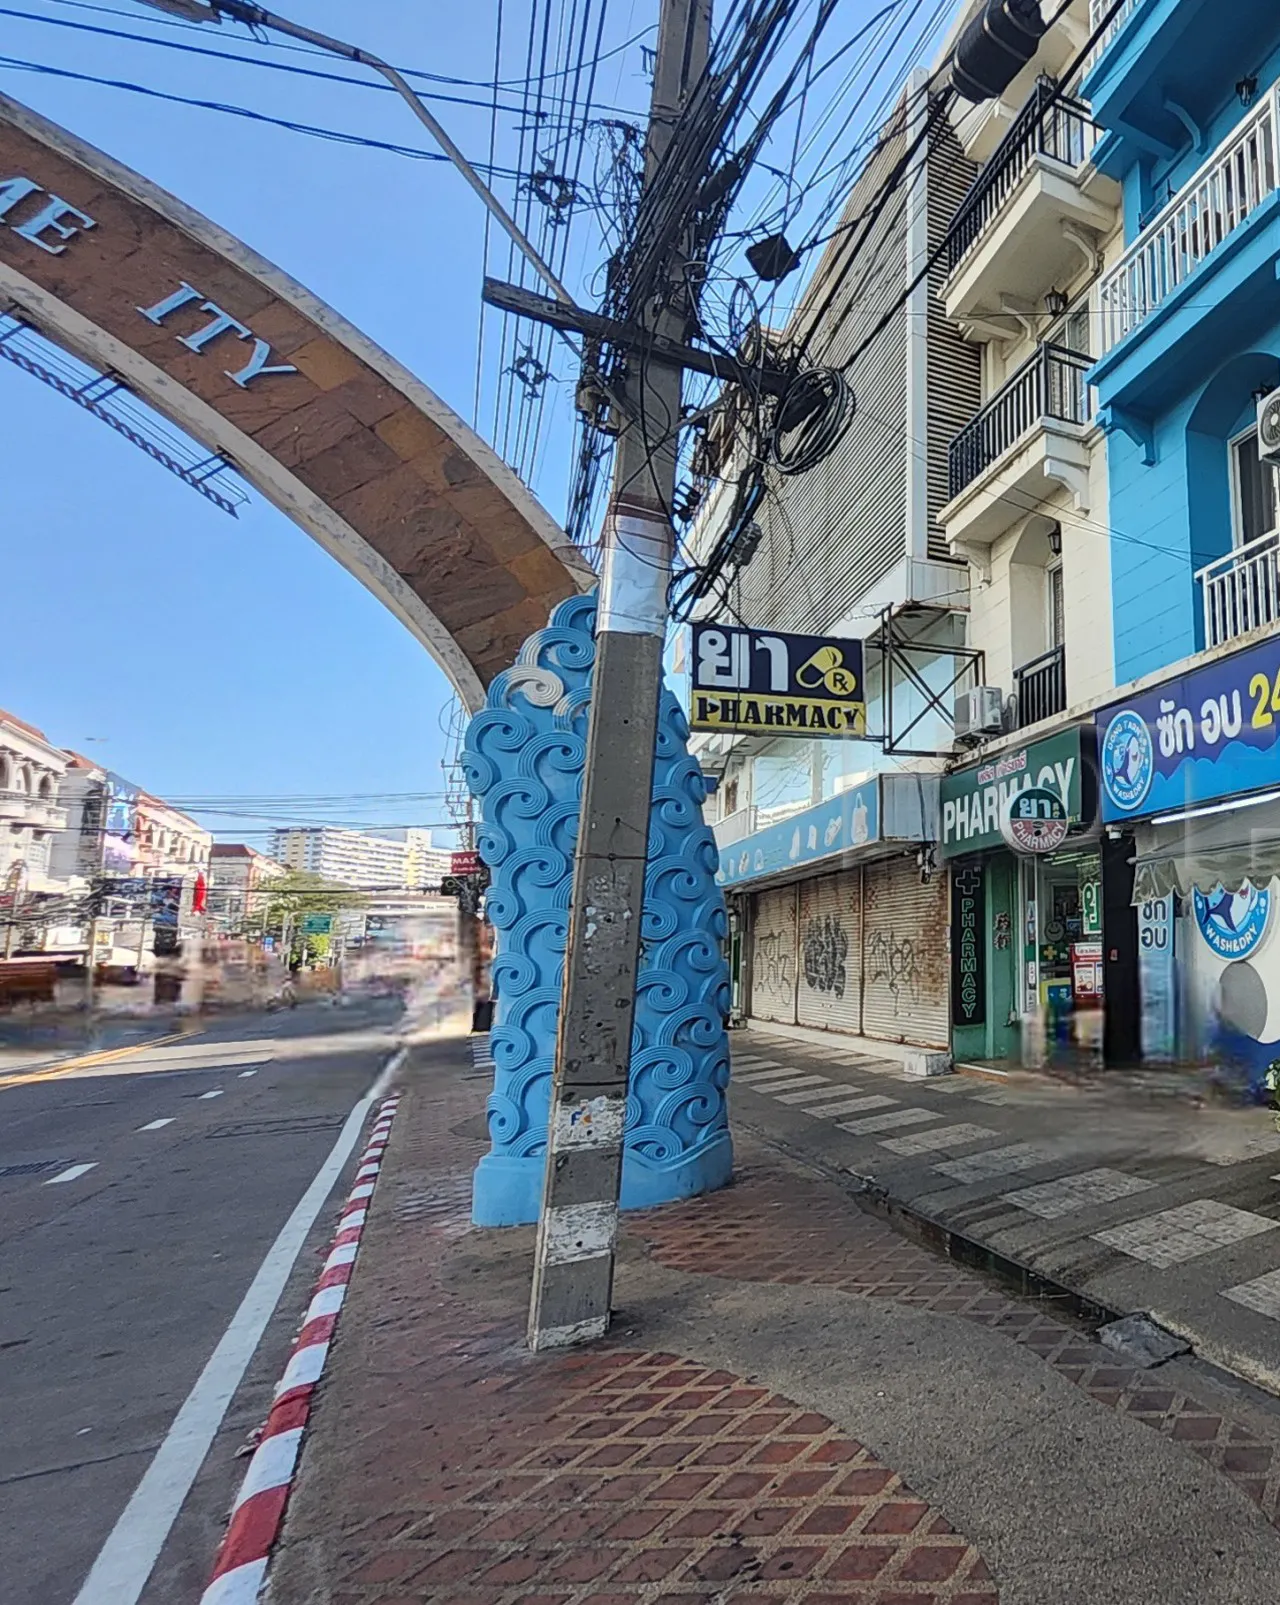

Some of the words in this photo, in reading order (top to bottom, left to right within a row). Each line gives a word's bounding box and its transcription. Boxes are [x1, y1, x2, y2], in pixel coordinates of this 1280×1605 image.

[697, 629, 789, 693] ยา
[696, 696, 860, 731] PHARMACY
[1156, 698, 1195, 759] ซัก
[1200, 689, 1243, 745] อบ
[1020, 797, 1051, 819] ยา
[1012, 821, 1065, 849] PHARMACY
[1141, 927, 1168, 948] อบ
[1206, 922, 1258, 952] WASH&DRY
[961, 897, 977, 1018] PHARMACY
